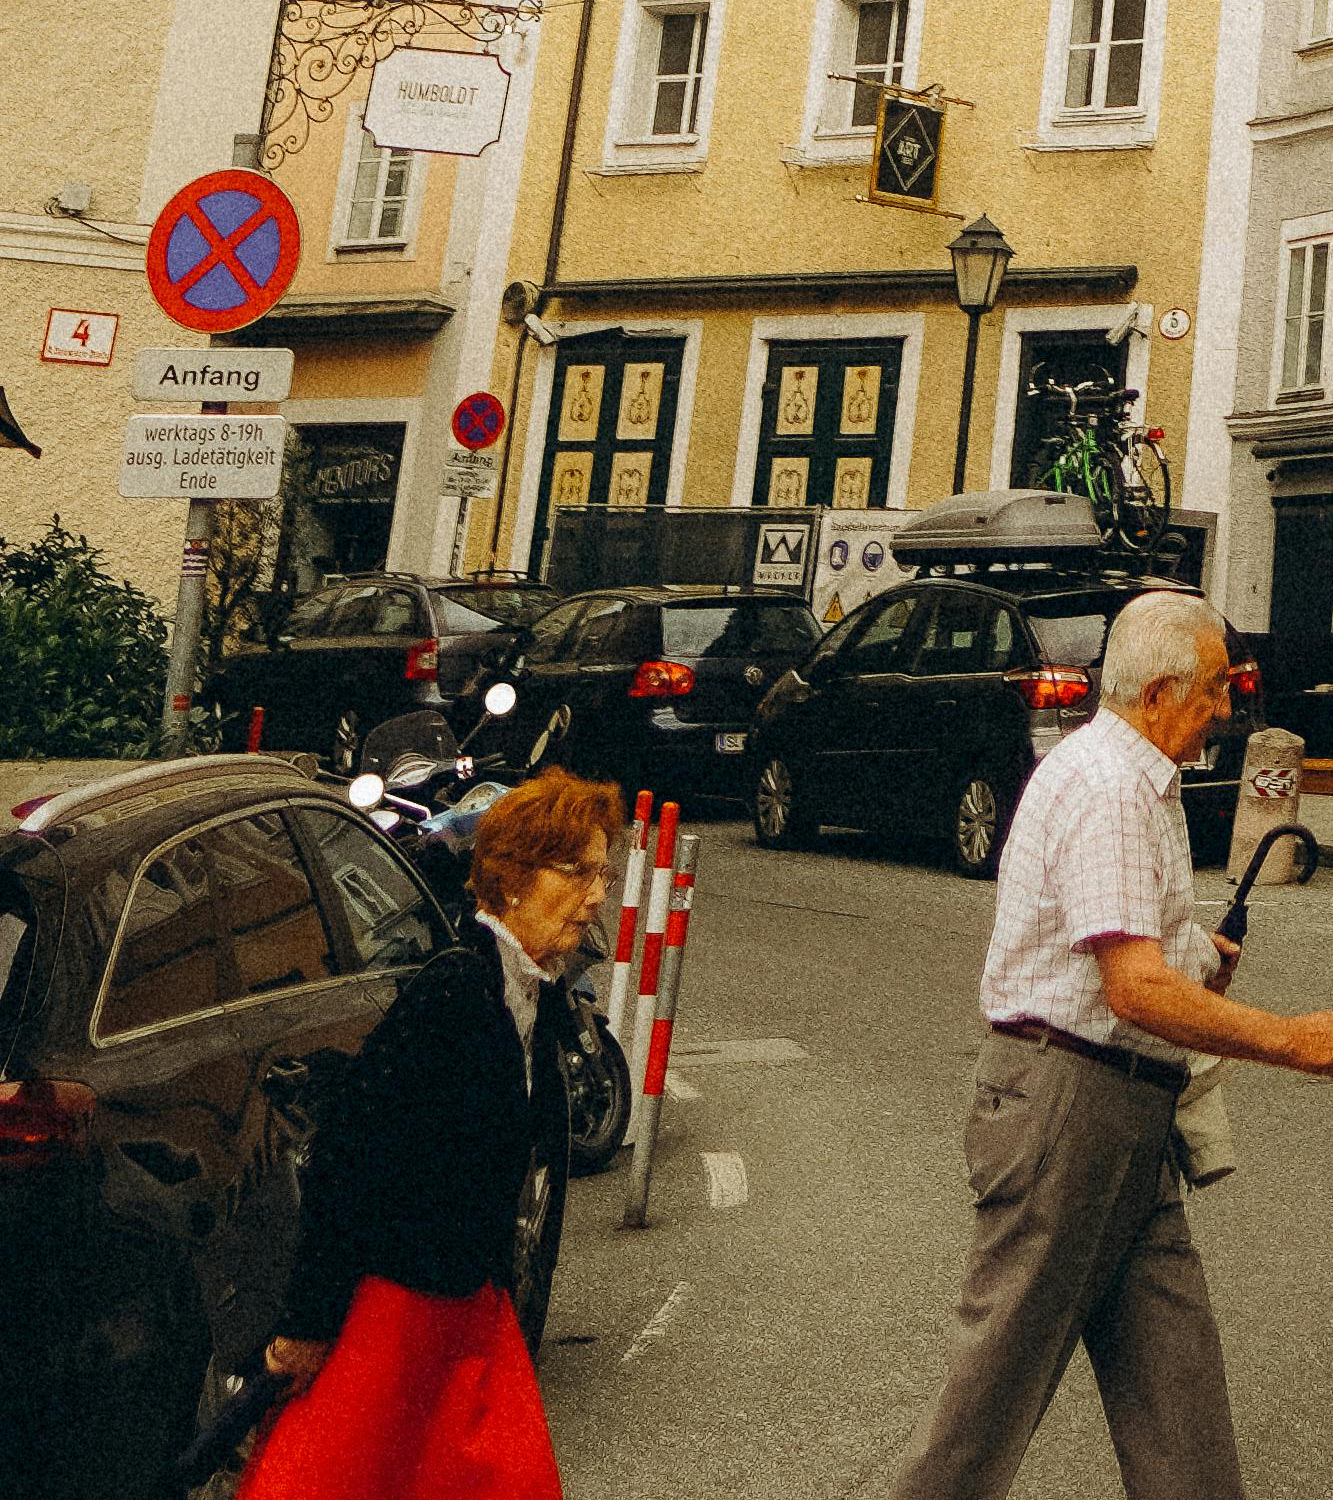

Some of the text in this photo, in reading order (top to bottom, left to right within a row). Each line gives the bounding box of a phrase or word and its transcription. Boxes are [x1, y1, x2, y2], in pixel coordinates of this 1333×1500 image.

[398, 81, 479, 106] HUMBOLDT
[71, 319, 91, 347] 4
[159, 364, 261, 392] Anfang
[144, 423, 264, 445] werktags 8-19h
[126, 445, 276, 470] ausg. Ladetätigkeit
[179, 471, 217, 489] Ende
